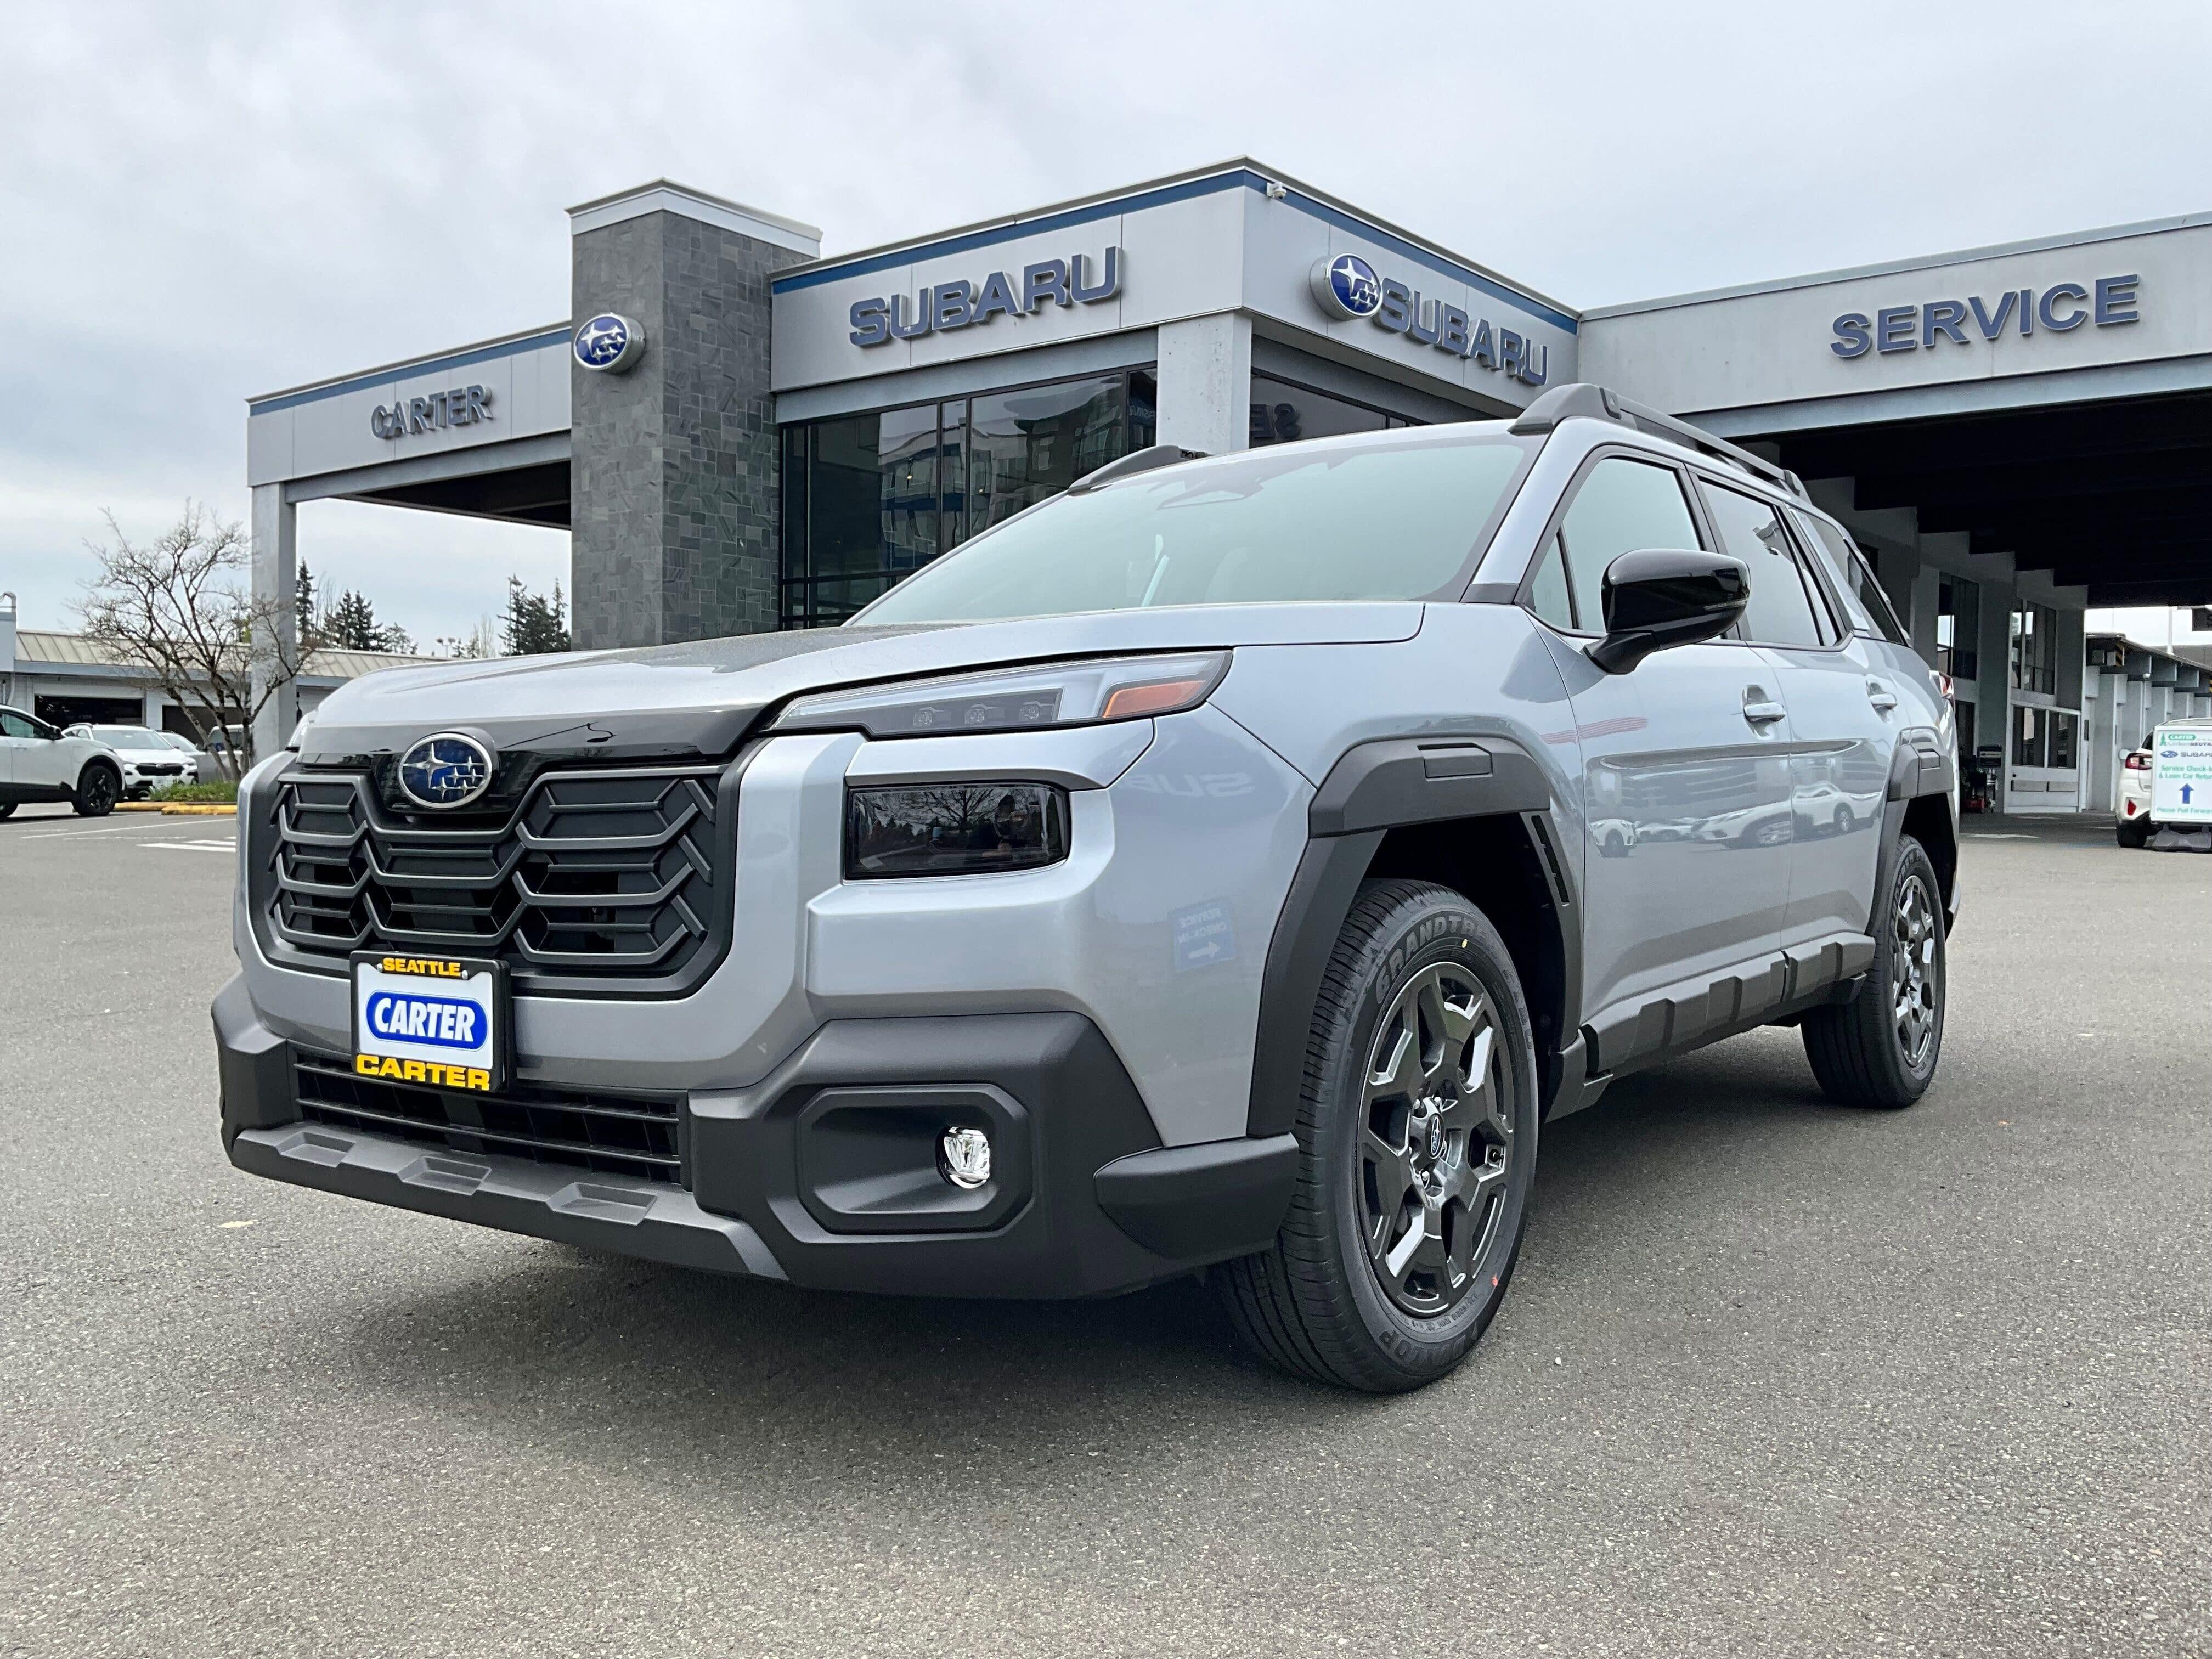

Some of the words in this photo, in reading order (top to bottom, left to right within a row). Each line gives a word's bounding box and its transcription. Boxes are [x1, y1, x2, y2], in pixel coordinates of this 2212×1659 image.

[849, 246, 1122, 347] SUBARU
[1830, 273, 2140, 358] SERVICE
[1373, 277, 1548, 385] SUBARU
[371, 385, 493, 439] CARTER
[383, 957, 461, 977] SEATTLE
[374, 997, 476, 1042] CARTER
[357, 1054, 490, 1091] CARTER
